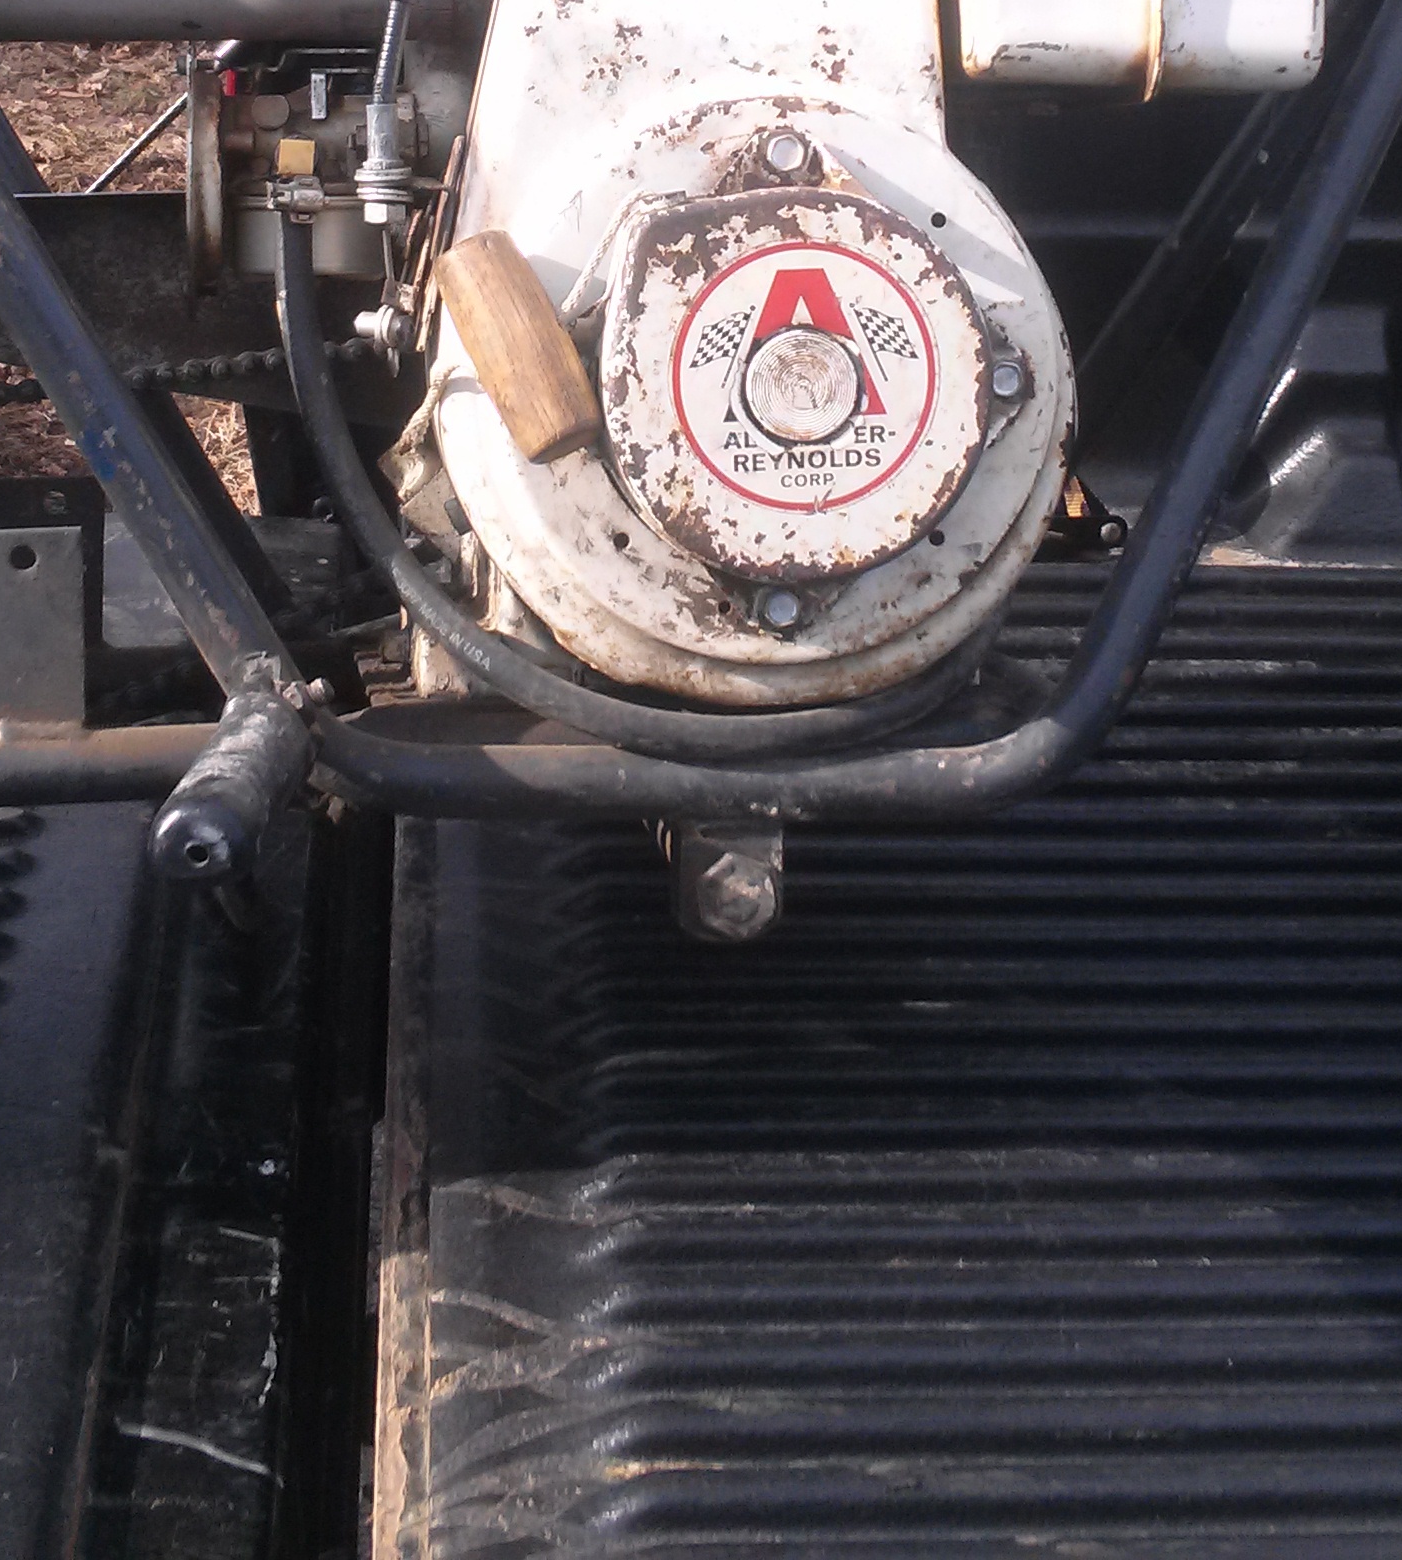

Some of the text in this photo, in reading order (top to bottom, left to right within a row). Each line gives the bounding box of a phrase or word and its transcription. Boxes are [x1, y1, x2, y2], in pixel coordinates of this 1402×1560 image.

[733, 448, 882, 473] REYNOLDS
[449, 631, 465, 648] IN
[463, 642, 491, 672] USA
